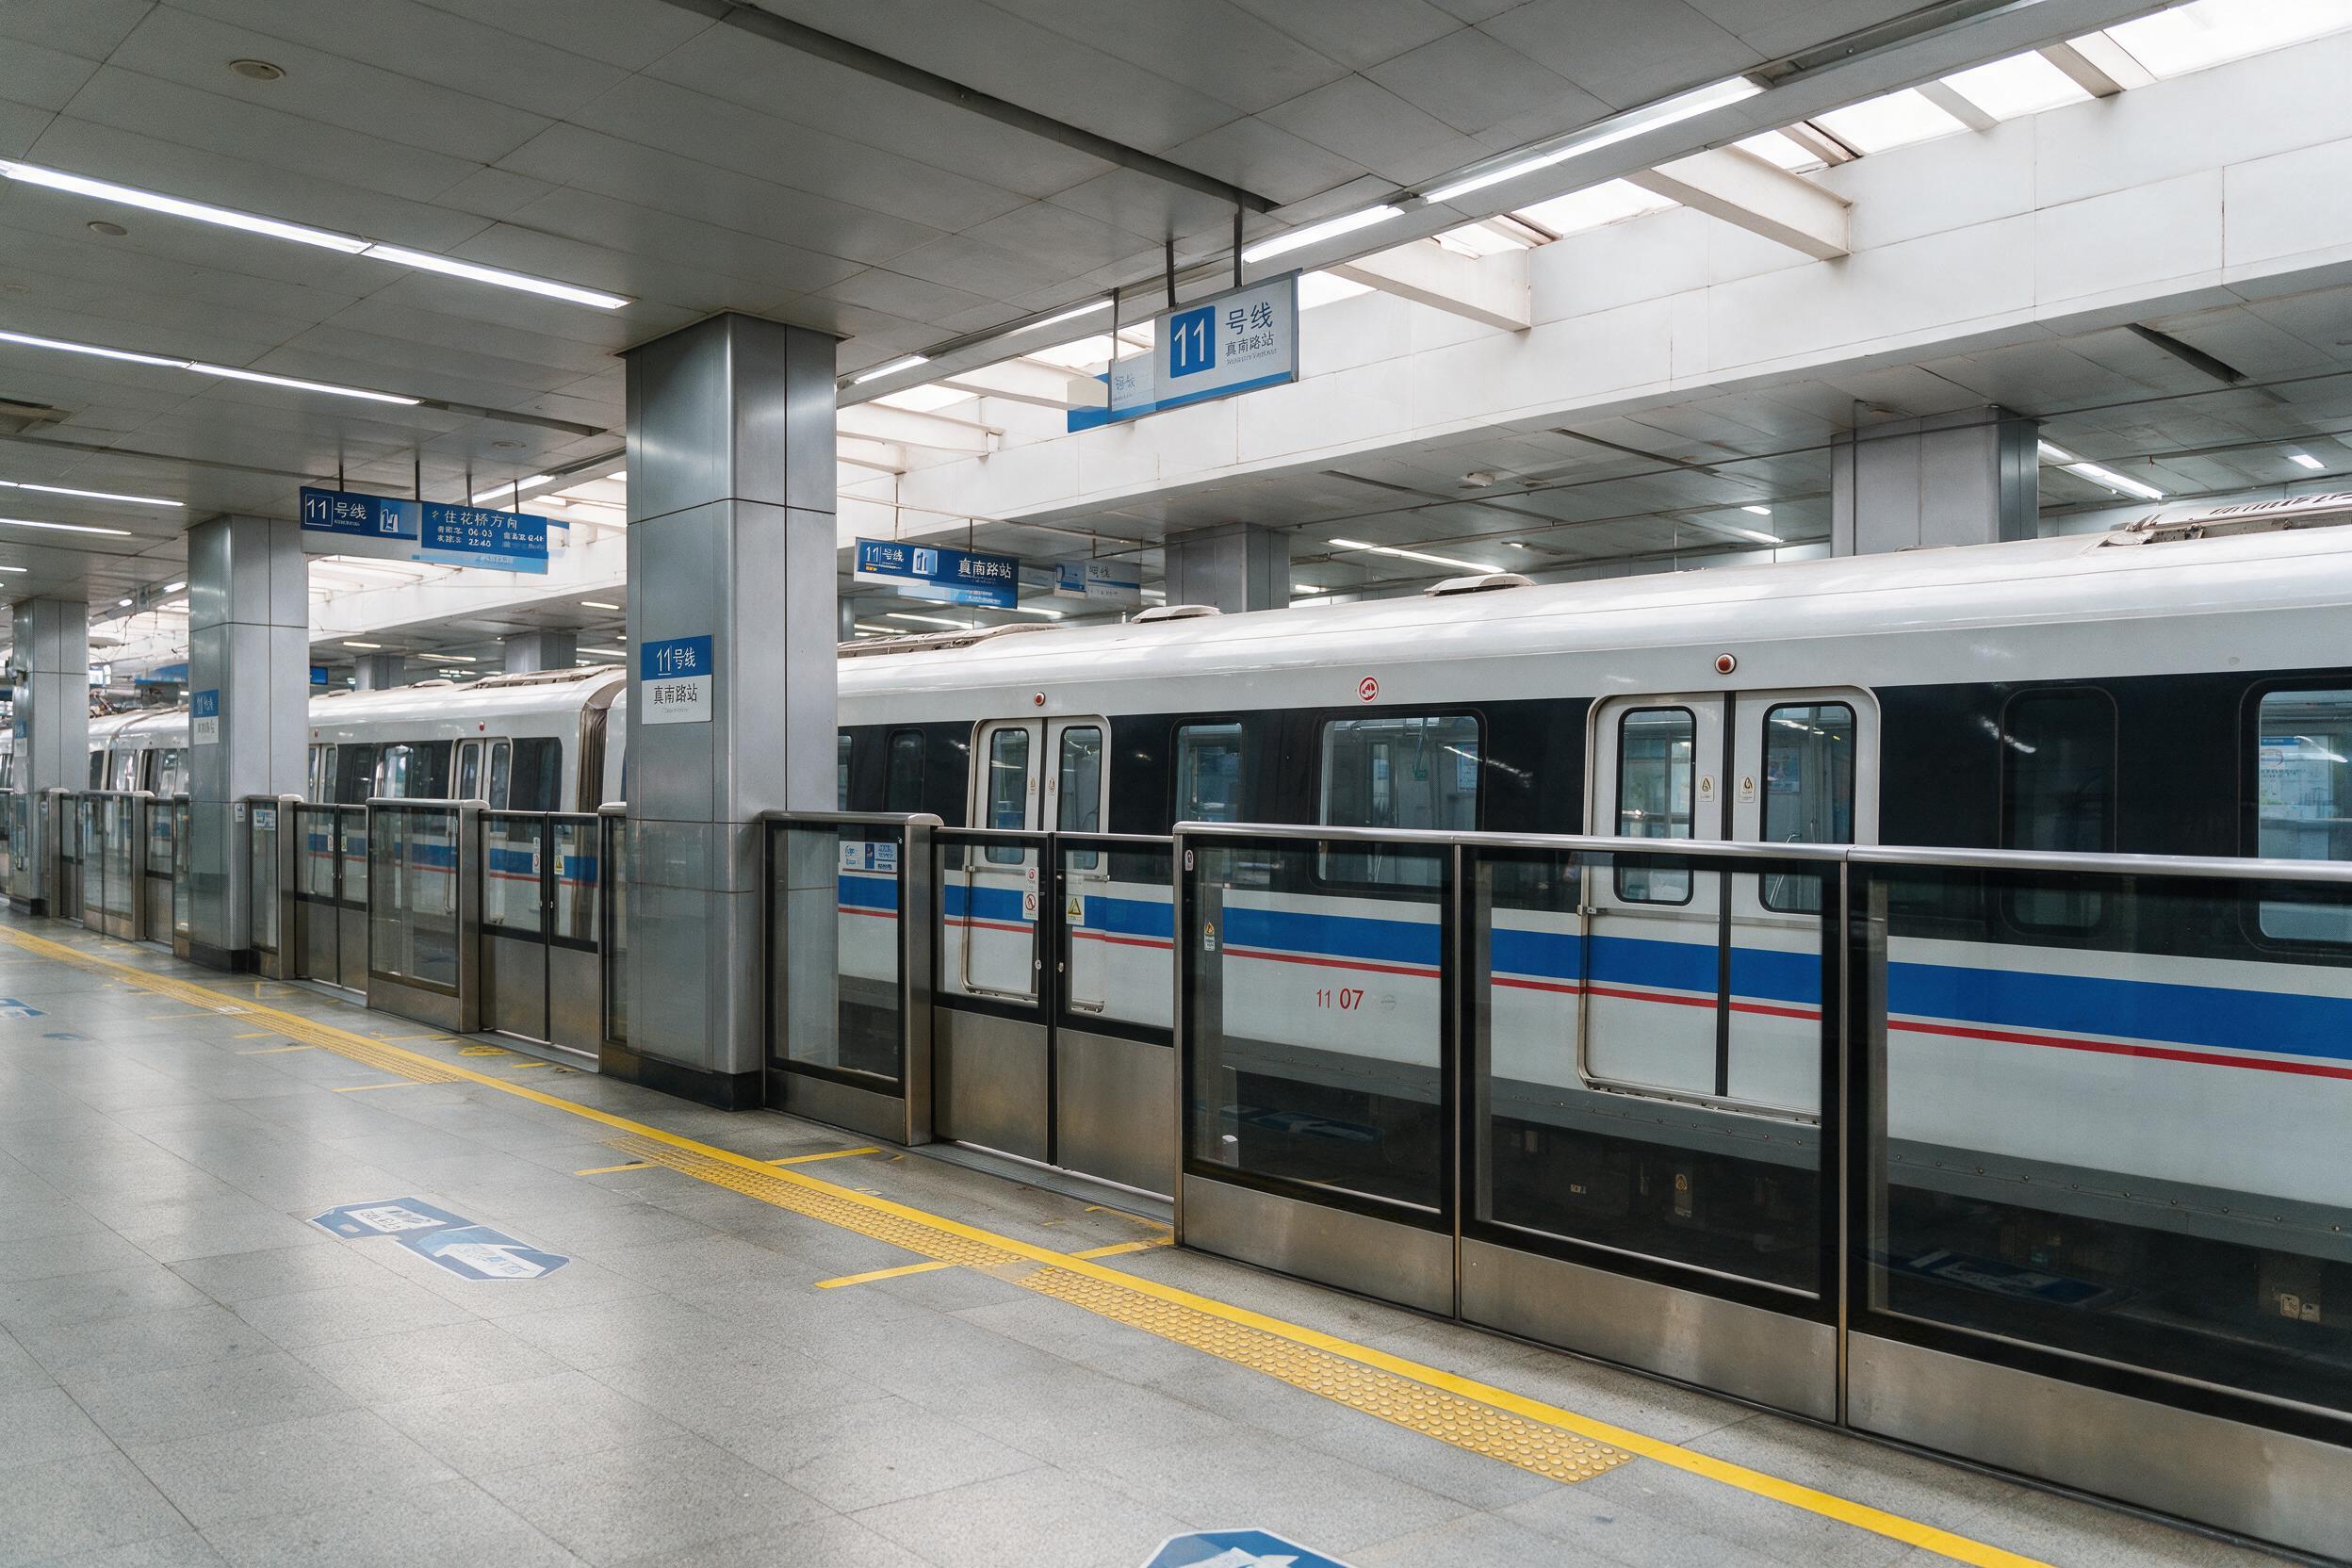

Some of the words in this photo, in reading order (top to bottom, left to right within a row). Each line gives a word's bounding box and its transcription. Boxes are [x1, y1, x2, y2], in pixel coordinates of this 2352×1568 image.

[1226, 302, 1273, 335] 号线
[1174, 317, 1205, 368] 11
[1225, 331, 1275, 357] 真南路站
[957, 557, 1012, 580] 真南路站
[654, 682, 698, 705] 真南路站
[1315, 988, 1331, 1009] 11
[1339, 988, 1364, 1010] 07
